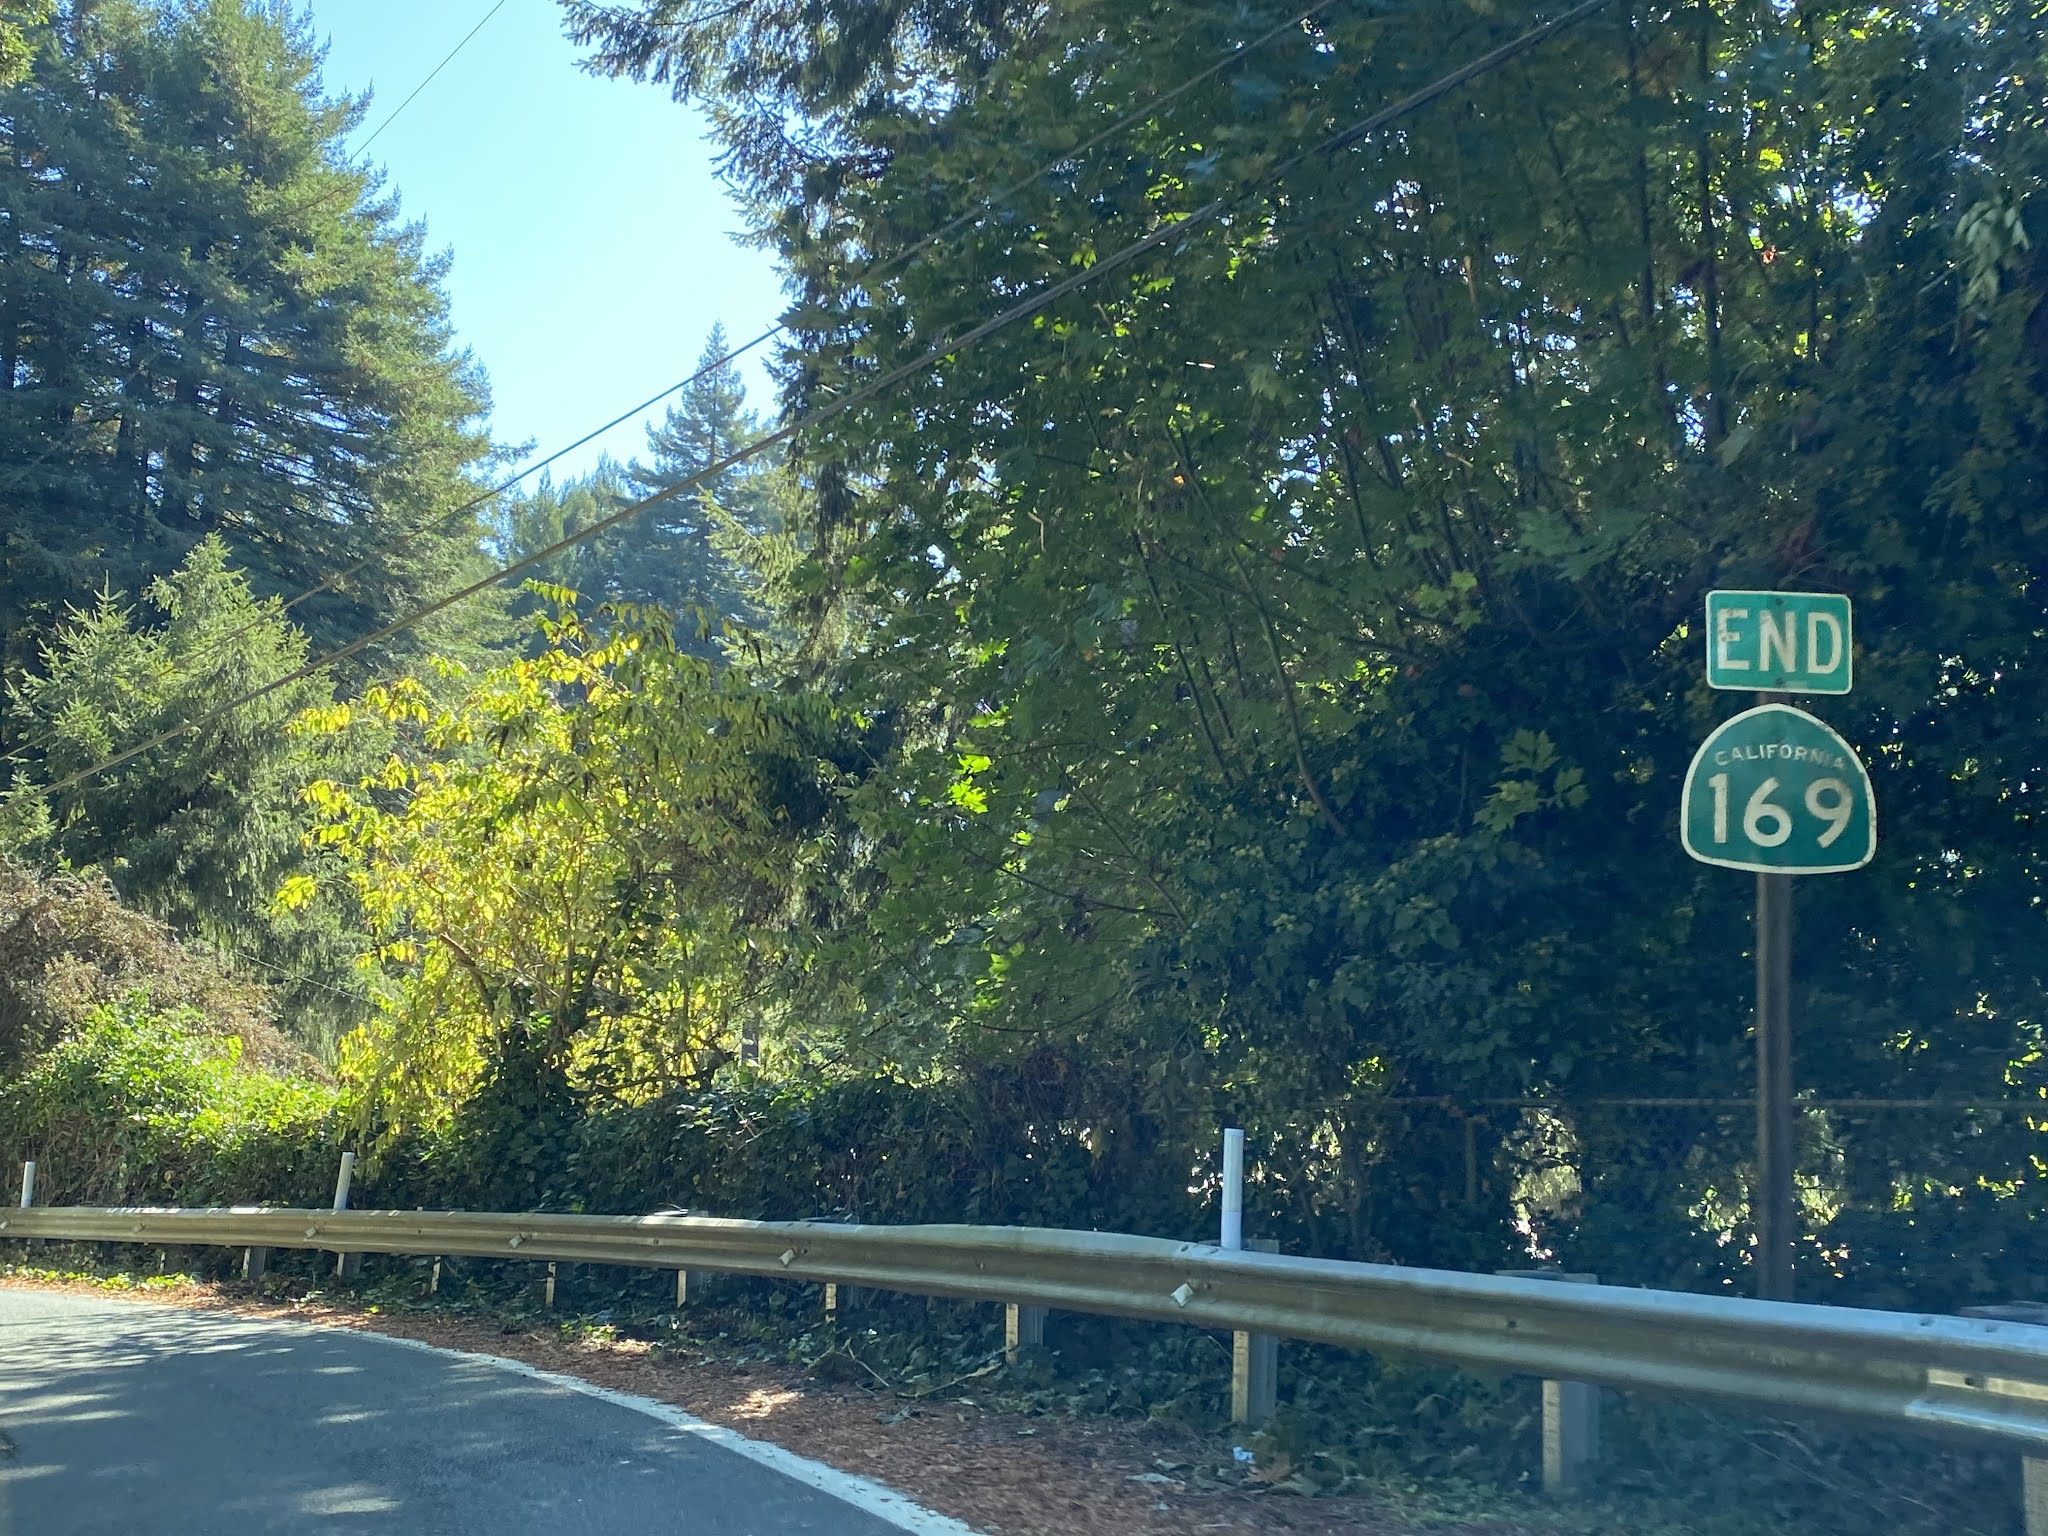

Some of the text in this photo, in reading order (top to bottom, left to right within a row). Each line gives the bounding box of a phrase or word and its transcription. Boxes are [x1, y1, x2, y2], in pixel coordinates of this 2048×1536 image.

[1717, 608, 1842, 674] END
[1714, 744, 1846, 769] CALIFORNIA
[1708, 773, 1853, 848] 169
